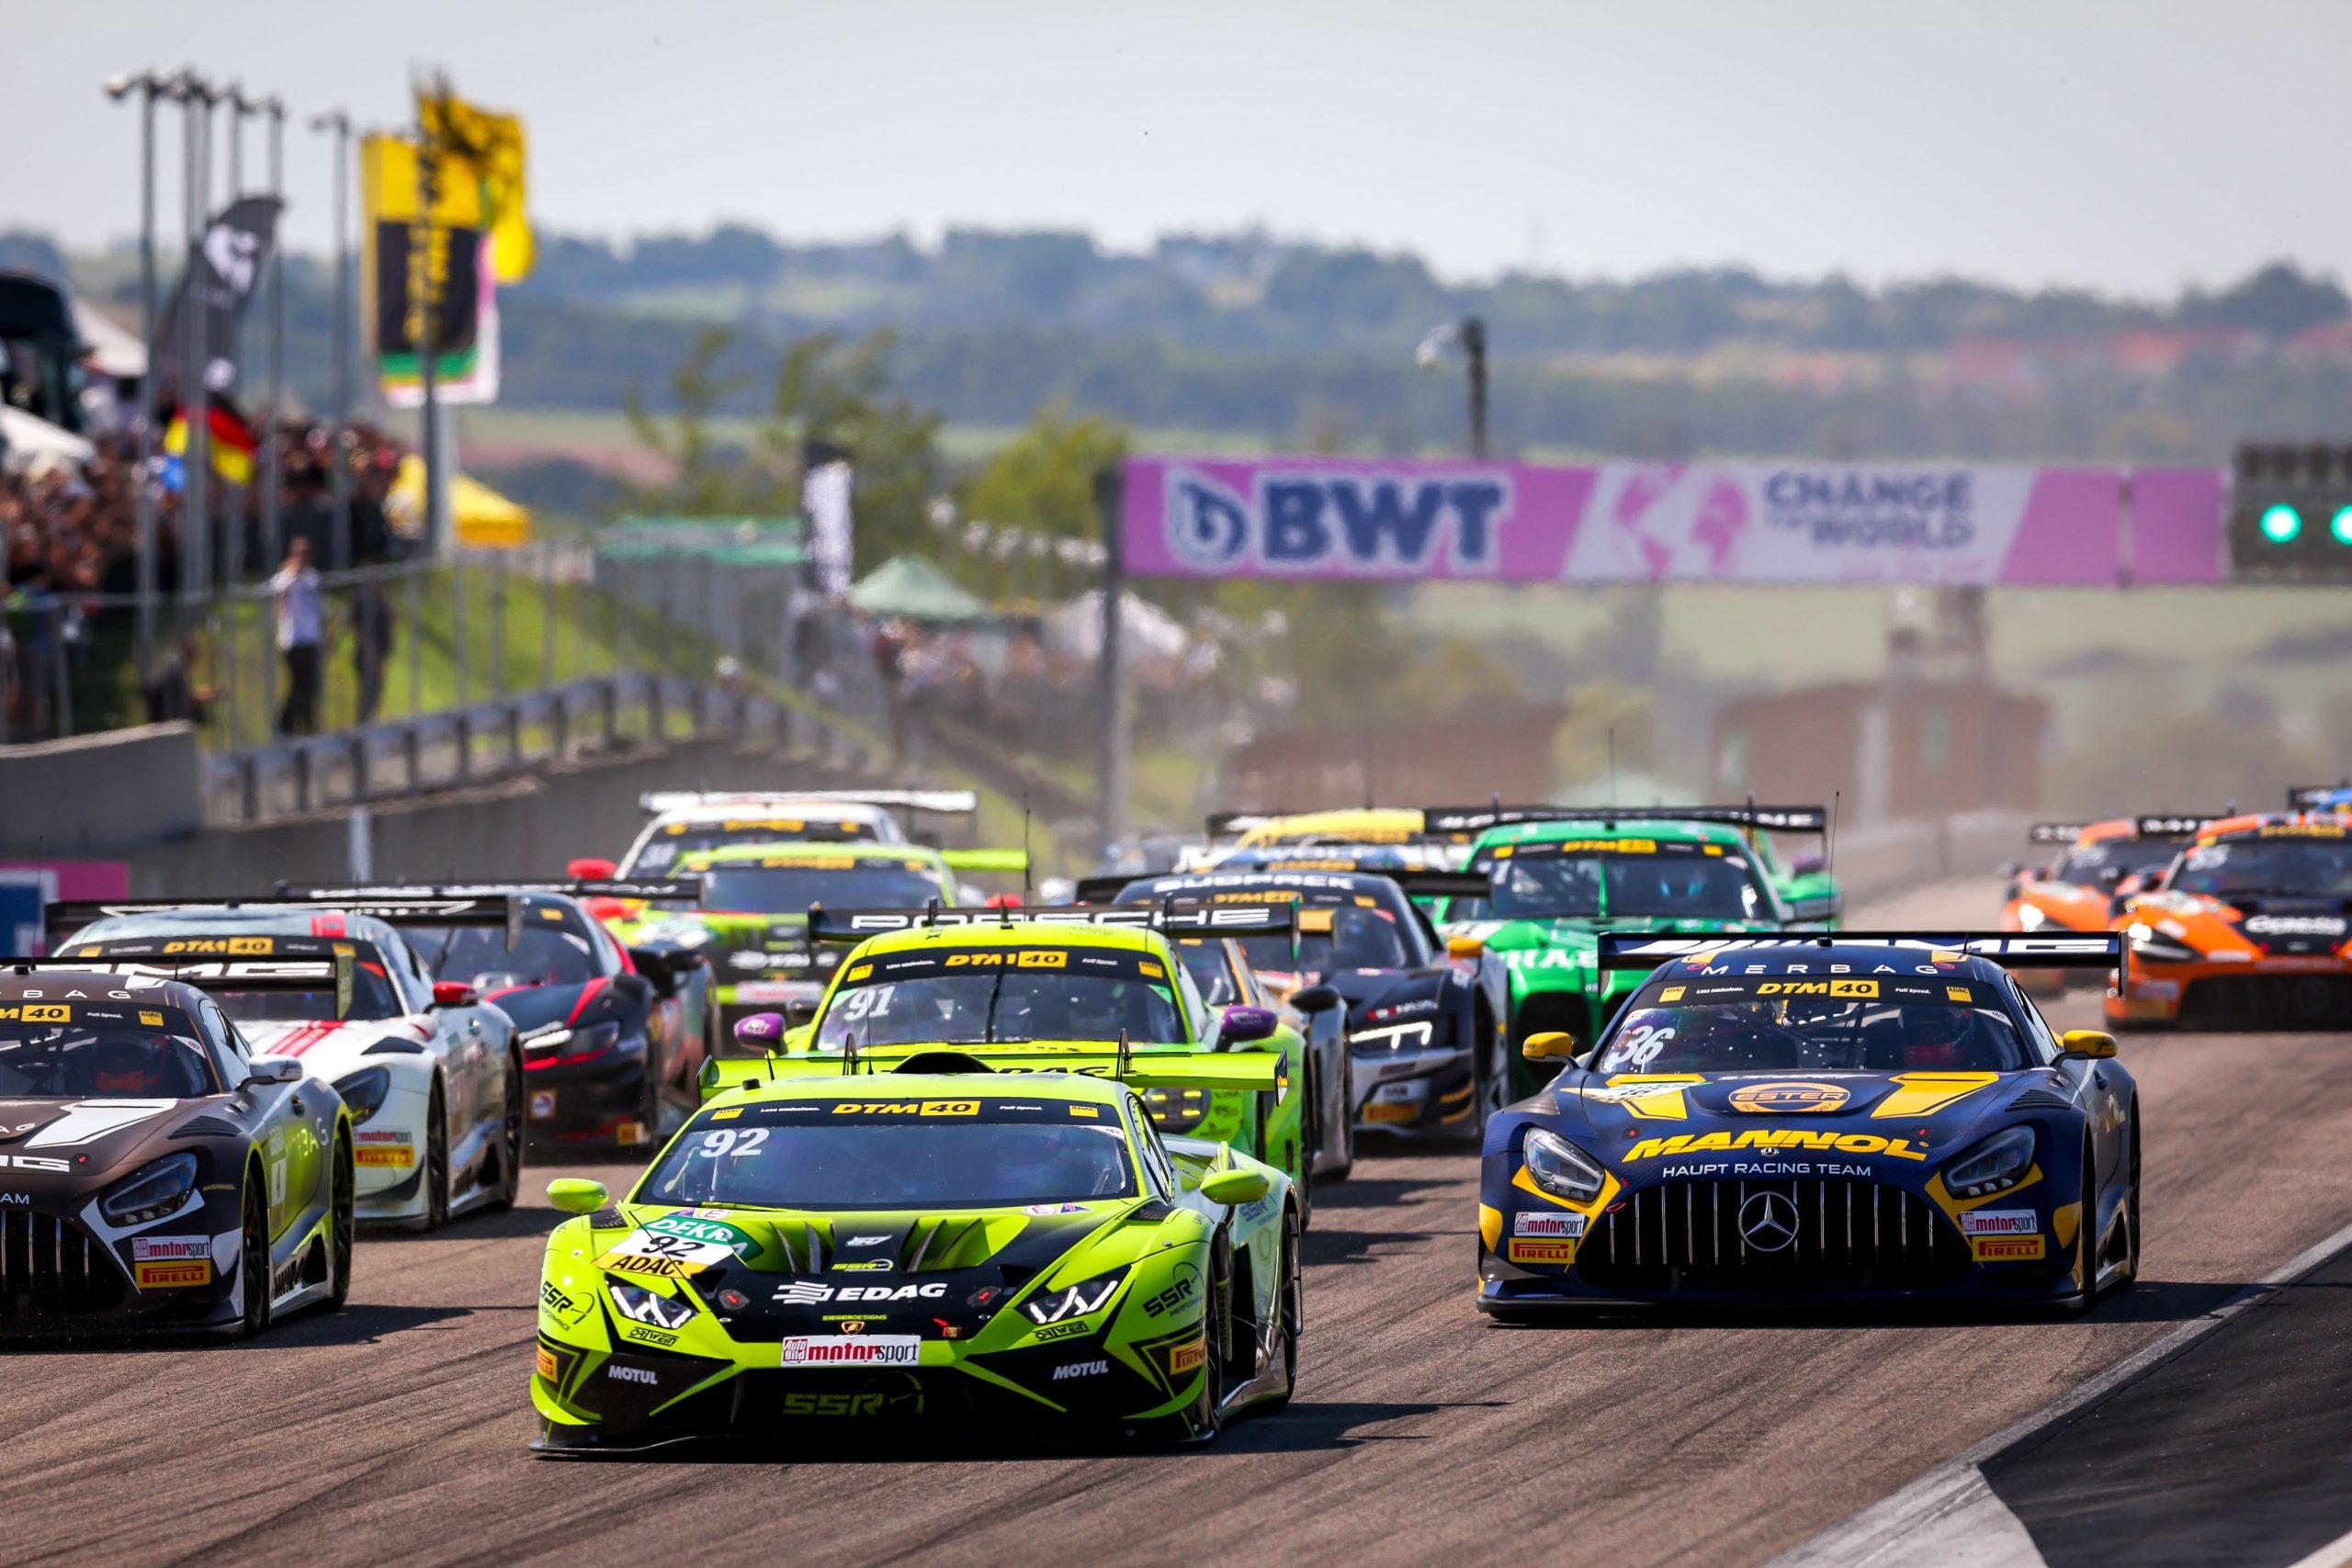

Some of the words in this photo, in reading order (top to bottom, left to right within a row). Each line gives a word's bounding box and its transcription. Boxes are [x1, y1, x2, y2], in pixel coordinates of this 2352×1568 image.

[1764, 470, 1973, 510] CHANGE
[1261, 479, 1507, 564] BWT
[1811, 513, 1974, 549] WORLD
[163, 940, 228, 953] DTM
[1025, 954, 1059, 964] 40
[1702, 964, 1939, 975] MERBAG
[0, 989, 131, 999] BAG
[1757, 983, 1828, 994] DTM
[1837, 984, 1872, 993] 40
[844, 985, 896, 1021] 91
[28, 1008, 64, 1018] 40
[1611, 1025, 1676, 1065] 36
[1736, 1090, 1844, 1100] ESTER
[831, 1104, 919, 1113] DTM
[928, 1104, 971, 1112] 40
[699, 1128, 770, 1157] 92
[1622, 1130, 1928, 1162] MANNOL
[1662, 1165, 1725, 1178] HAUPT
[1735, 1163, 1811, 1175] RACING
[1816, 1164, 1871, 1177] TEAM
[1528, 1218, 1582, 1235] motorsport
[1975, 1216, 2036, 1232] motorsport
[641, 1236, 706, 1257] 92
[647, 1219, 748, 1256] DEKRA
[149, 1242, 209, 1258] motorsport
[1514, 1243, 1568, 1258] PIRELLI
[1979, 1240, 2039, 1256] PIRELLI
[142, 1266, 204, 1283] PIRELLI
[610, 1256, 684, 1275] ADAC
[539, 1280, 574, 1313] SSR
[835, 1283, 948, 1301] EDAG
[1143, 1279, 1193, 1318] SSR
[808, 1342, 917, 1362] motorsport
[608, 1365, 658, 1384] MOTUL
[1053, 1359, 1109, 1380] MOTUL
[783, 1393, 884, 1416] SSR
